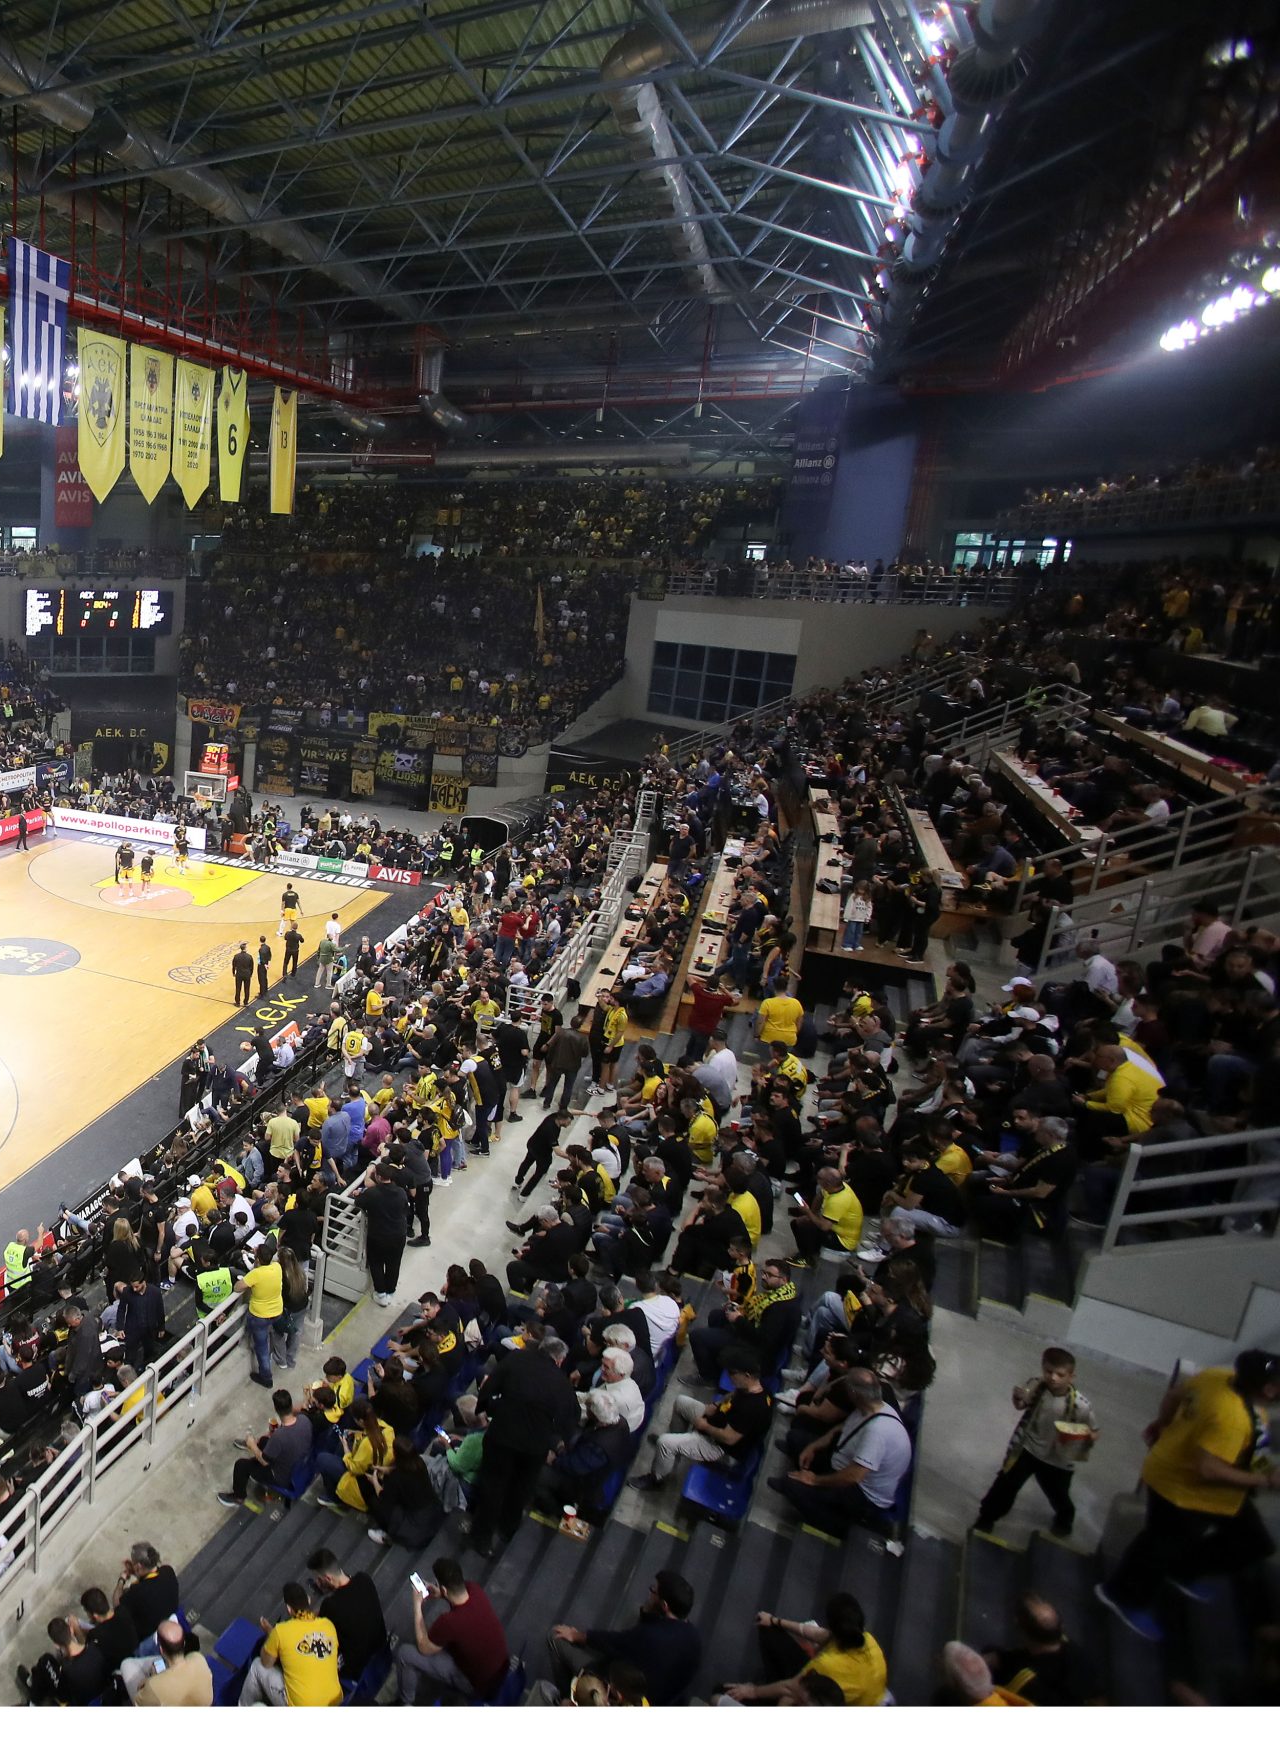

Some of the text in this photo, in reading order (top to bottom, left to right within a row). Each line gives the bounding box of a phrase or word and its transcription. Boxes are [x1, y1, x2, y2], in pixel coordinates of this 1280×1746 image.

[228, 423, 238, 456] 6
[280, 430, 288, 449] 13
[793, 458, 822, 469] Allianz
[57, 471, 87, 484] AVI
[57, 490, 91, 503] AVIS
[95, 728, 124, 738] A.E.K.
[204, 752, 218, 763] 24
[300, 748, 347, 762] VIRNAS
[278, 854, 300, 864] Allianz
[300, 869, 377, 889] LEAGUE
[377, 867, 412, 884] AVIS
[349, 1040, 356, 1048] 9
[205, 1279, 227, 1288] ALFA
